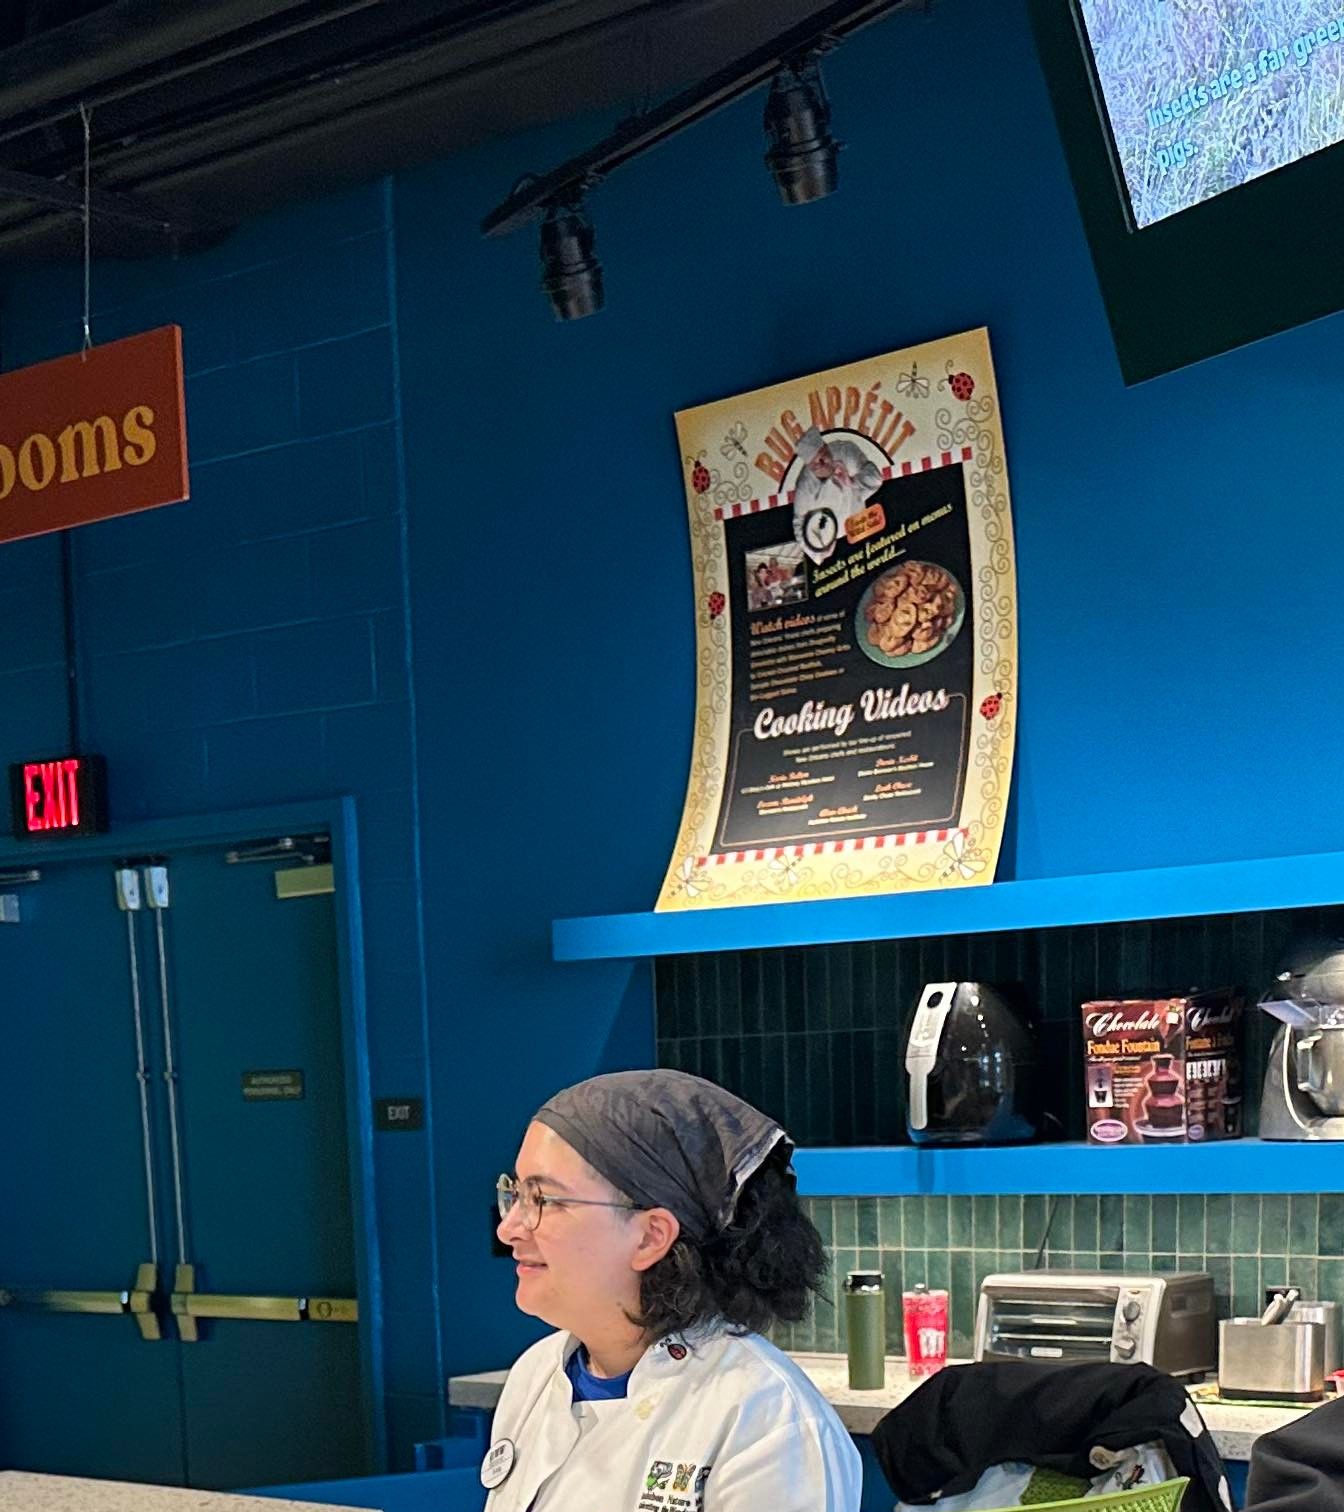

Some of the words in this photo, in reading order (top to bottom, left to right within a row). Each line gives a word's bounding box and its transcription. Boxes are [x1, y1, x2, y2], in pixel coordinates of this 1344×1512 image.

[1145, 88, 1208, 130] Insects
[1209, 67, 1243, 100] are
[1243, 62, 1257, 83] a
[1258, 47, 1289, 77] far
[1155, 140, 1199, 175] pigs.
[754, 409, 806, 484] BUG
[808, 381, 917, 458] APPÉTIT
[865, 524, 906, 559] featured
[754, 699, 855, 740] Cooking
[860, 682, 951, 722] Videos
[25, 760, 79, 831] EXIT
[1086, 1010, 1160, 1037] Chocolate
[1087, 1039, 1120, 1055] Fondue
[1121, 1036, 1160, 1053] Fountain
[387, 1105, 410, 1121] EXIT
